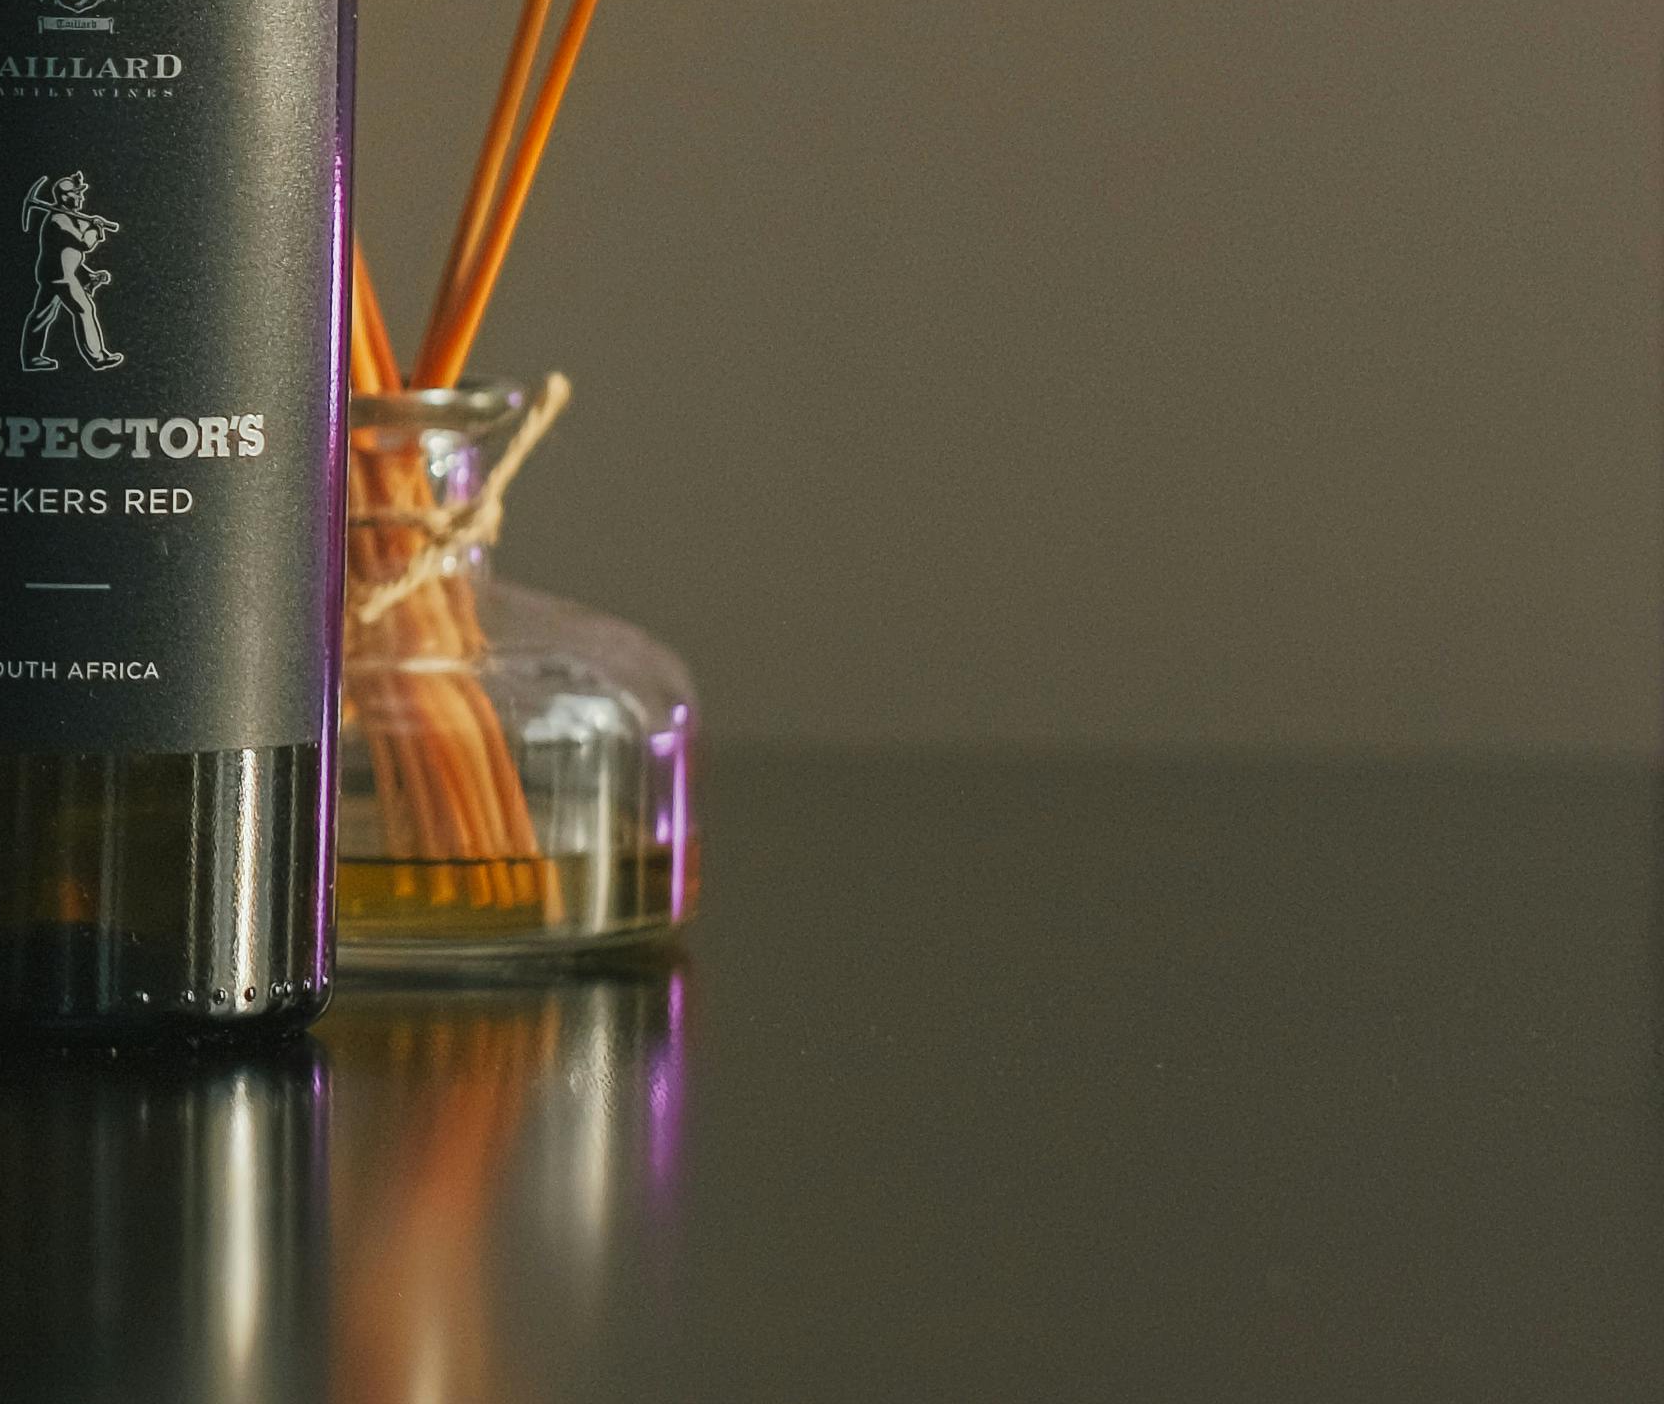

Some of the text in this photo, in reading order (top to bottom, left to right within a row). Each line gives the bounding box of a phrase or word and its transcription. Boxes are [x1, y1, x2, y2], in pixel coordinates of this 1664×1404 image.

[92, 87, 173, 98] WINES
[124, 487, 194, 515] RED
[68, 660, 160, 681] AFRICA
